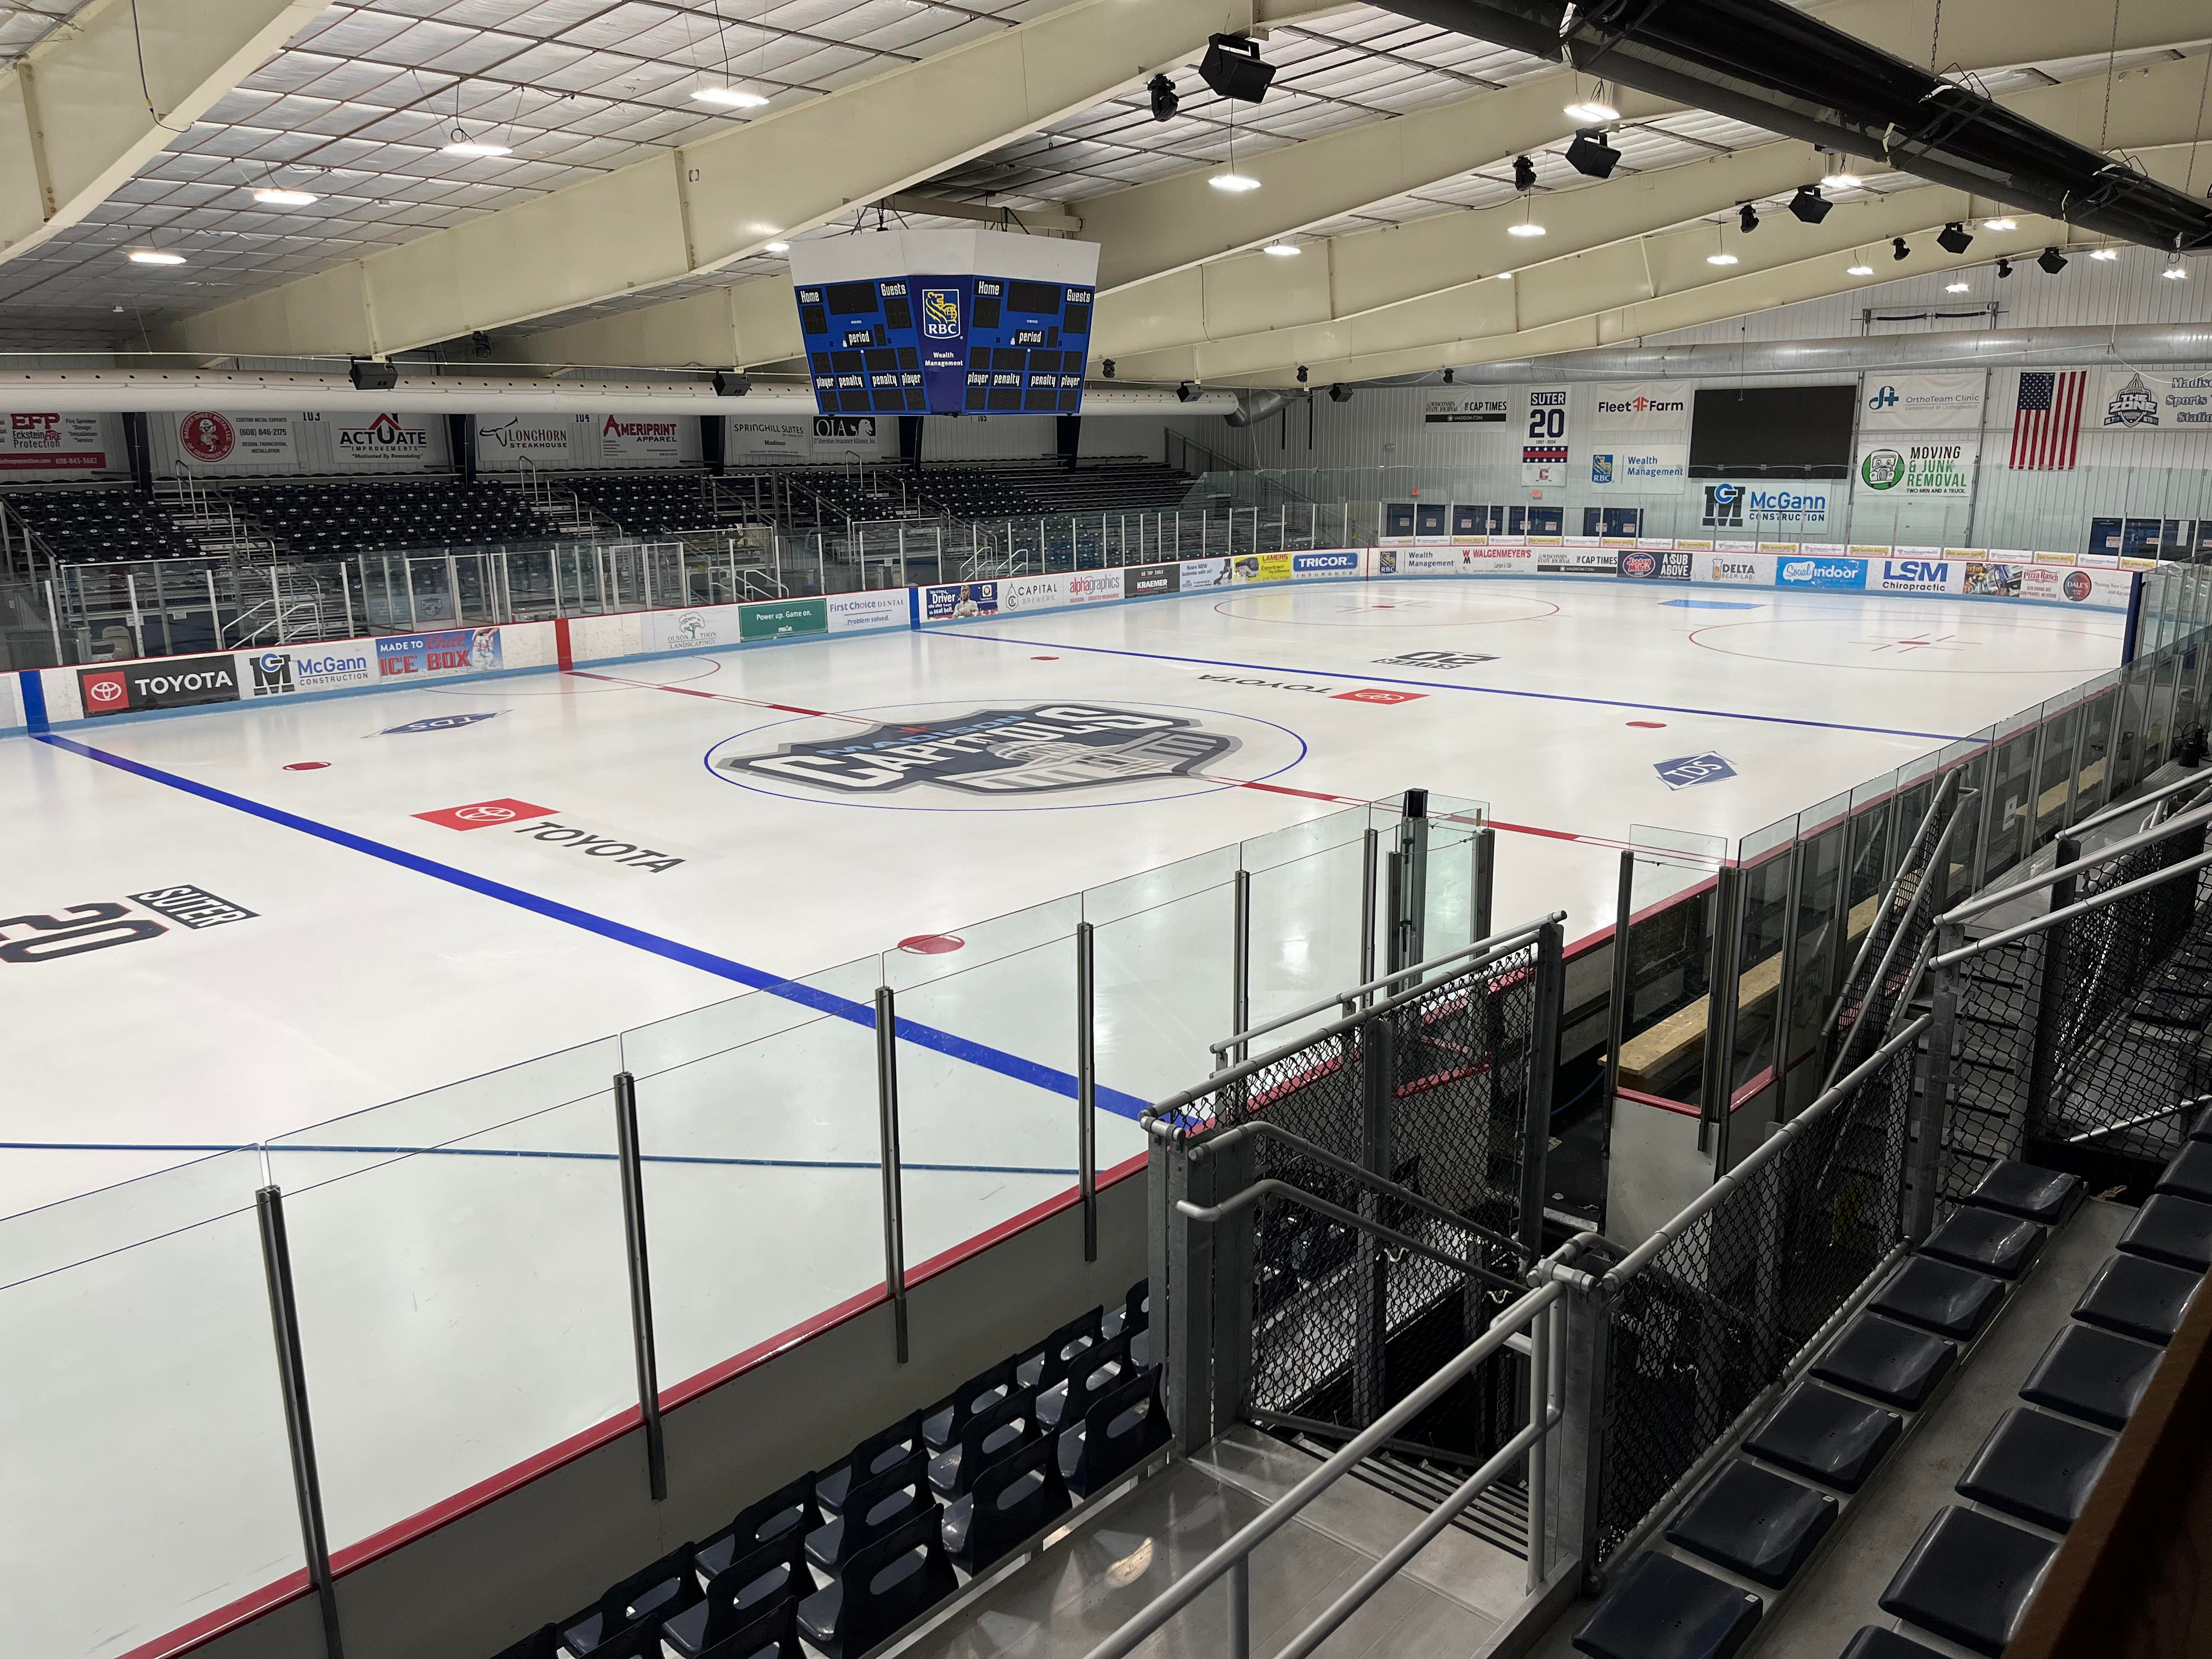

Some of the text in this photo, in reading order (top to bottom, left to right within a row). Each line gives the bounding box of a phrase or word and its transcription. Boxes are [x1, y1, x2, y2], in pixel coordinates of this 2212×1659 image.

[881, 283, 906, 296] Guests
[978, 281, 1000, 295] Home
[800, 290, 820, 303] Home
[1067, 289, 1090, 302] Guests
[928, 324, 956, 335] RBC
[848, 330, 870, 346] period
[1019, 331, 1042, 345] period
[816, 373, 921, 389] player penalty penalty player
[968, 372, 1080, 387] player penalty penalty player
[1532, 393, 1565, 405] SUTER
[2166, 394, 2208, 407] Sports
[1470, 402, 1483, 411] CAP
[1485, 401, 1507, 411] TIMES
[1599, 400, 1683, 412] Fleet Farm
[2109, 400, 2157, 413] ZONE
[10, 413, 60, 430] EFP
[603, 415, 676, 438] AMERIPRINT
[816, 419, 848, 437] OIA
[1529, 408, 1565, 438] 20
[13, 430, 45, 439] Eckstein
[239, 428, 287, 437] (608) 846-2175
[340, 425, 427, 445] ACTUATE
[509, 429, 567, 442] LONGHORN
[734, 424, 804, 434] SPRINGHILL SUITES
[14, 439, 60, 448] Protection
[1910, 446, 1961, 459] MOVING
[1628, 456, 1657, 464] Wealth
[1909, 460, 1955, 473] & JUNK
[1627, 467, 1683, 477] Management
[1907, 473, 1967, 487] REMOVAL
[1750, 492, 1825, 510] McGann
[1473, 550, 1532, 558] WALGENMEYER'S
[1582, 556, 1595, 564] CAP
[1597, 556, 1617, 565] TIMES
[1662, 554, 1688, 565] A SUB
[1299, 557, 1347, 567] TRICOR
[1627, 557, 1651, 566] Jersey
[1660, 565, 1689, 576] ABOVE
[1722, 564, 1755, 574] DELTA
[1786, 565, 1811, 577] Social
[1883, 561, 1949, 583] LSM
[2023, 571, 2058, 582] Pizza Ranch
[1018, 583, 1057, 596] CAPITAL
[1070, 574, 1120, 595] alphagraphics
[1137, 579, 1168, 589] KRAEMER
[1882, 582, 1945, 591] Chiropractic
[932, 593, 955, 604] Driver
[1023, 595, 1055, 604] BREWERY
[830, 603, 848, 612] First
[380, 631, 466, 653] MADE TO Chill
[298, 656, 366, 676] McGann
[380, 649, 472, 676] ICE BOX
[134, 670, 233, 696] TOYOTA
[300, 673, 368, 686] CONSTRUCTION
[1197, 674, 1333, 694] TOYOTA
[815, 715, 1027, 755] MADISON
[746, 706, 1181, 788] CAPITOLS
[1662, 761, 1723, 779] TDS
[514, 821, 686, 873] TOYOTA
[138, 887, 246, 927] SUTER
